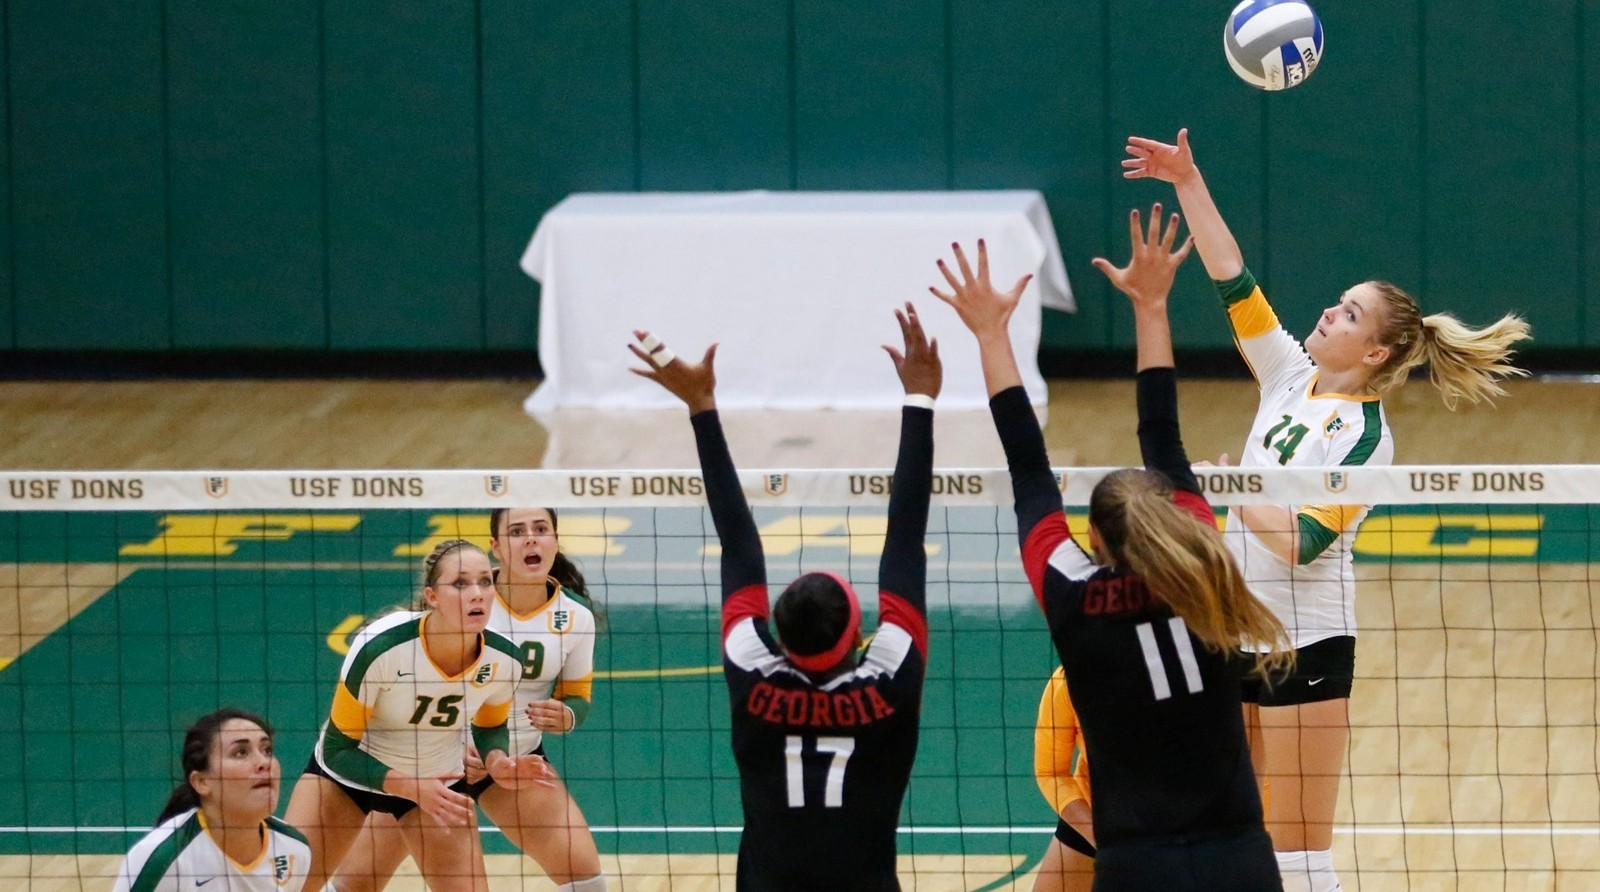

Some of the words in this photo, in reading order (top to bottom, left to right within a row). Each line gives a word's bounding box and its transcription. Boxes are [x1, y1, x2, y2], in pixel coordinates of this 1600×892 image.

[1262, 414, 1310, 466] 14
[9, 480, 60, 500] USF
[71, 479, 145, 499] DONS
[290, 478, 342, 498] USF
[352, 477, 424, 497] DONS
[569, 477, 621, 496] USF
[631, 476, 703, 496] DONS
[930, 475, 983, 494] ONS
[1409, 472, 1462, 492] USF
[1472, 471, 1545, 491] DONS
[519, 640, 545, 680] 9
[1135, 616, 1204, 701] 11
[408, 694, 465, 727] 15
[746, 681, 896, 727] GEORGIA
[785, 735, 856, 809] 17
